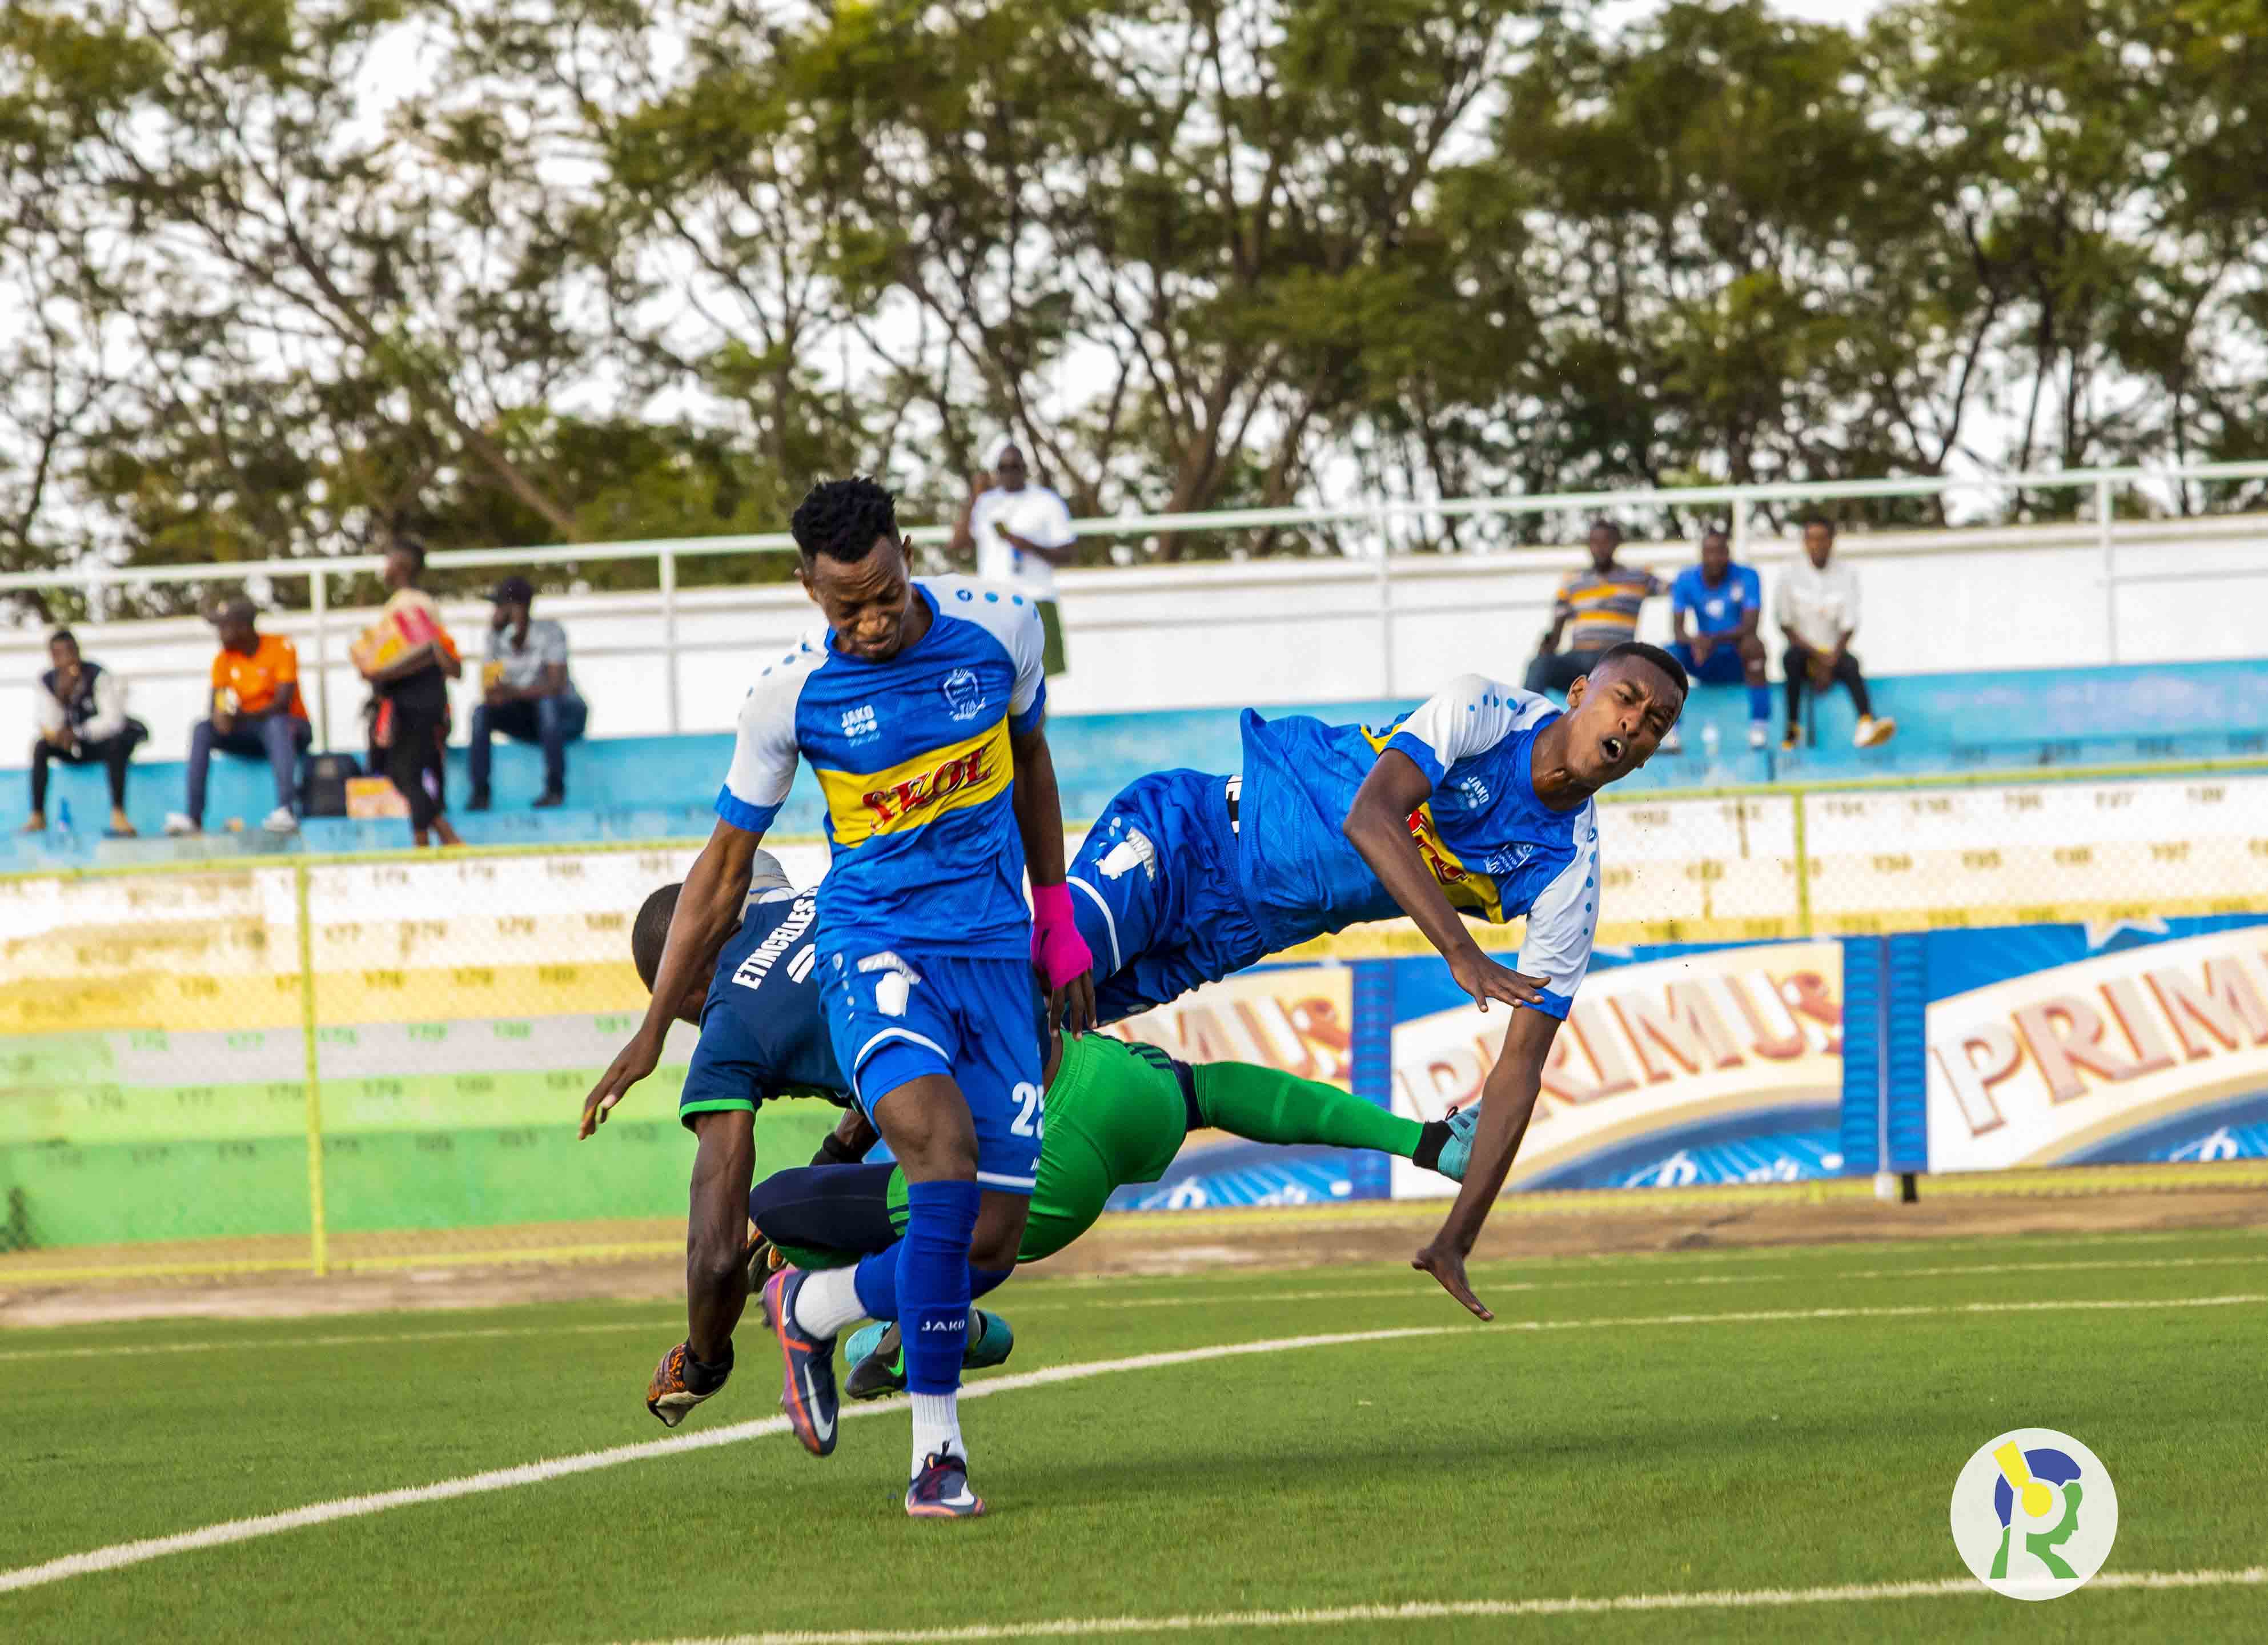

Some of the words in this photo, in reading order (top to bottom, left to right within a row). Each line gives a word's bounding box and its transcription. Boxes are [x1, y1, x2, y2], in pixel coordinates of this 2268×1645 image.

[841, 704, 874, 728] JAKO
[862, 746, 993, 833] SKOL
[1467, 775, 1490, 804] JAKO
[732, 898, 817, 990] ETINCELLES
[1929, 948, 2268, 1138] PRIM
[921, 1319, 965, 1331] JAKO
